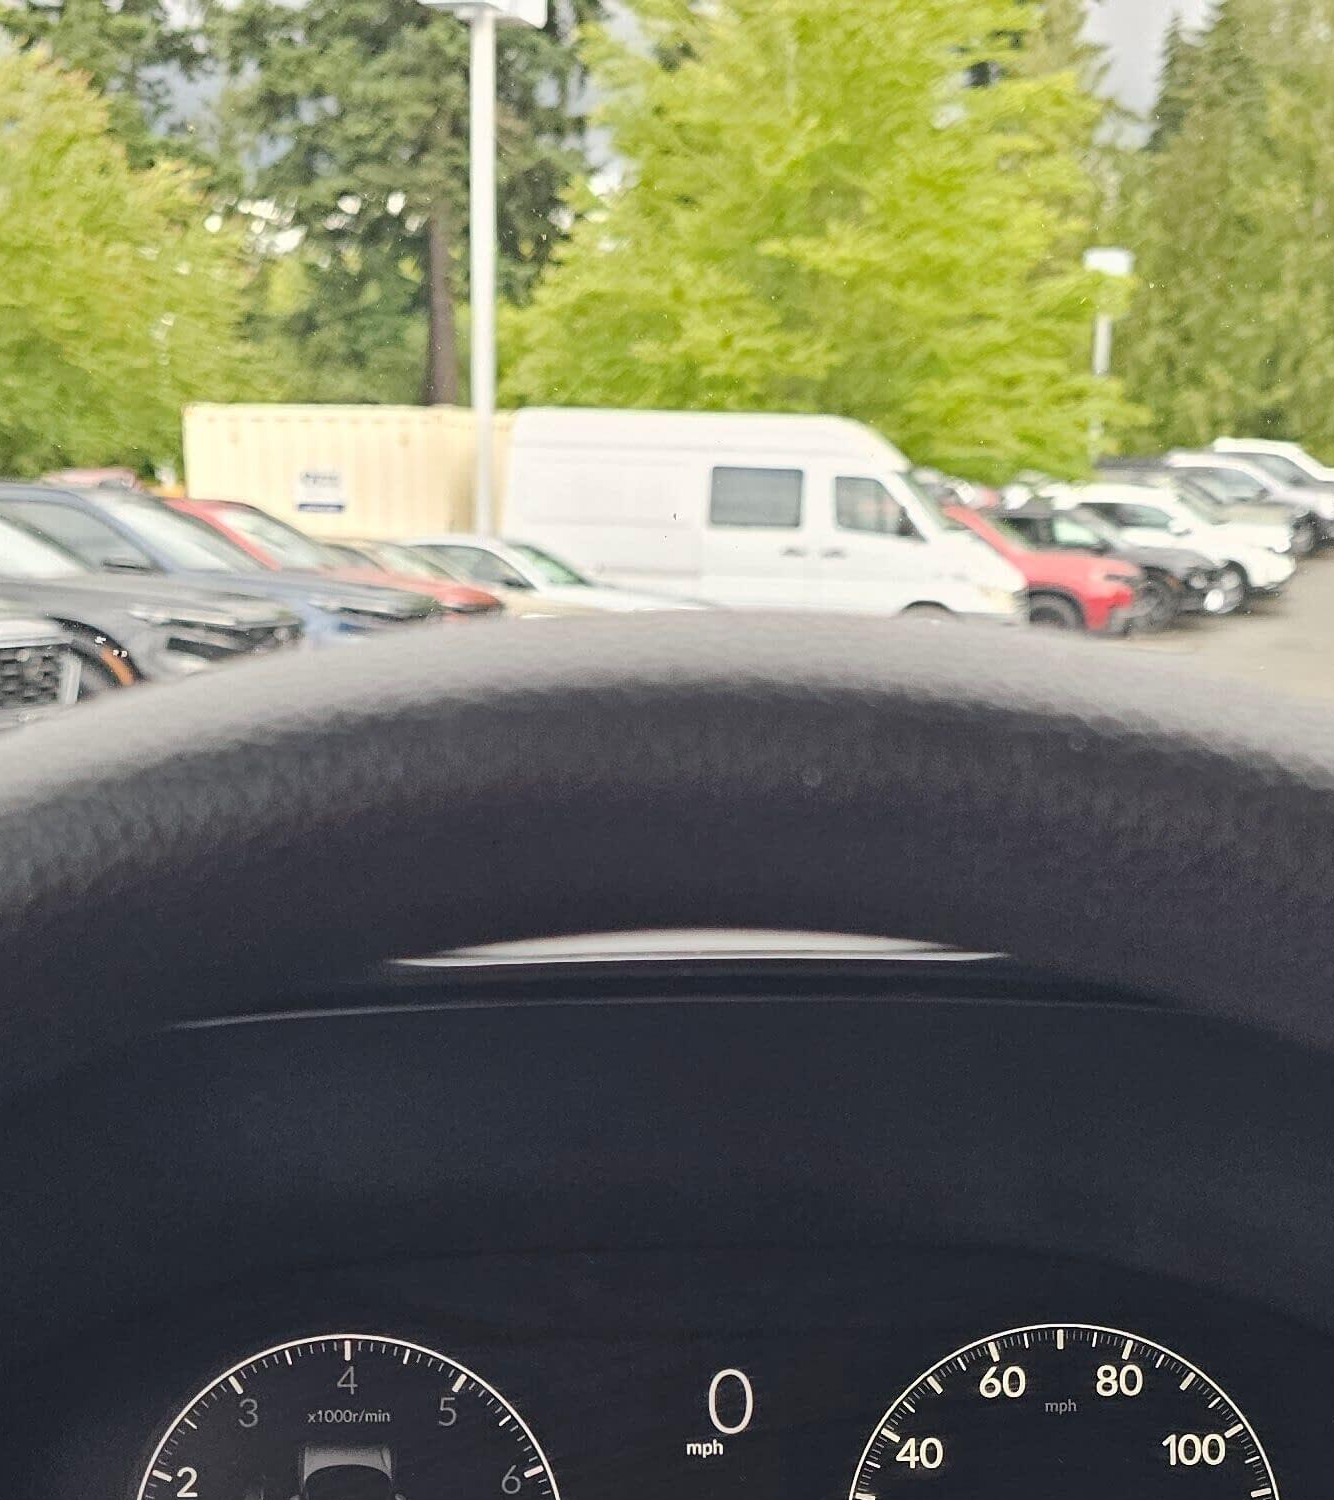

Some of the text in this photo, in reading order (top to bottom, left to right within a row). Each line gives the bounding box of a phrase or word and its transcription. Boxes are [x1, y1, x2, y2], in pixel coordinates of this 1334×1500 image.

[336, 1365, 358, 1395] 4
[978, 1365, 1027, 1399] 60
[1096, 1364, 1143, 1397] 80
[237, 1398, 260, 1429] 3
[307, 1409, 391, 1423] x1000r/min
[437, 1396, 459, 1428] 5
[708, 1368, 754, 1435] 0
[1044, 1398, 1077, 1415] mph
[686, 1438, 724, 1459] mph
[895, 1437, 945, 1470] 40
[1161, 1433, 1227, 1467] 100
[175, 1466, 199, 1499] 2
[500, 1464, 522, 1495] 6
